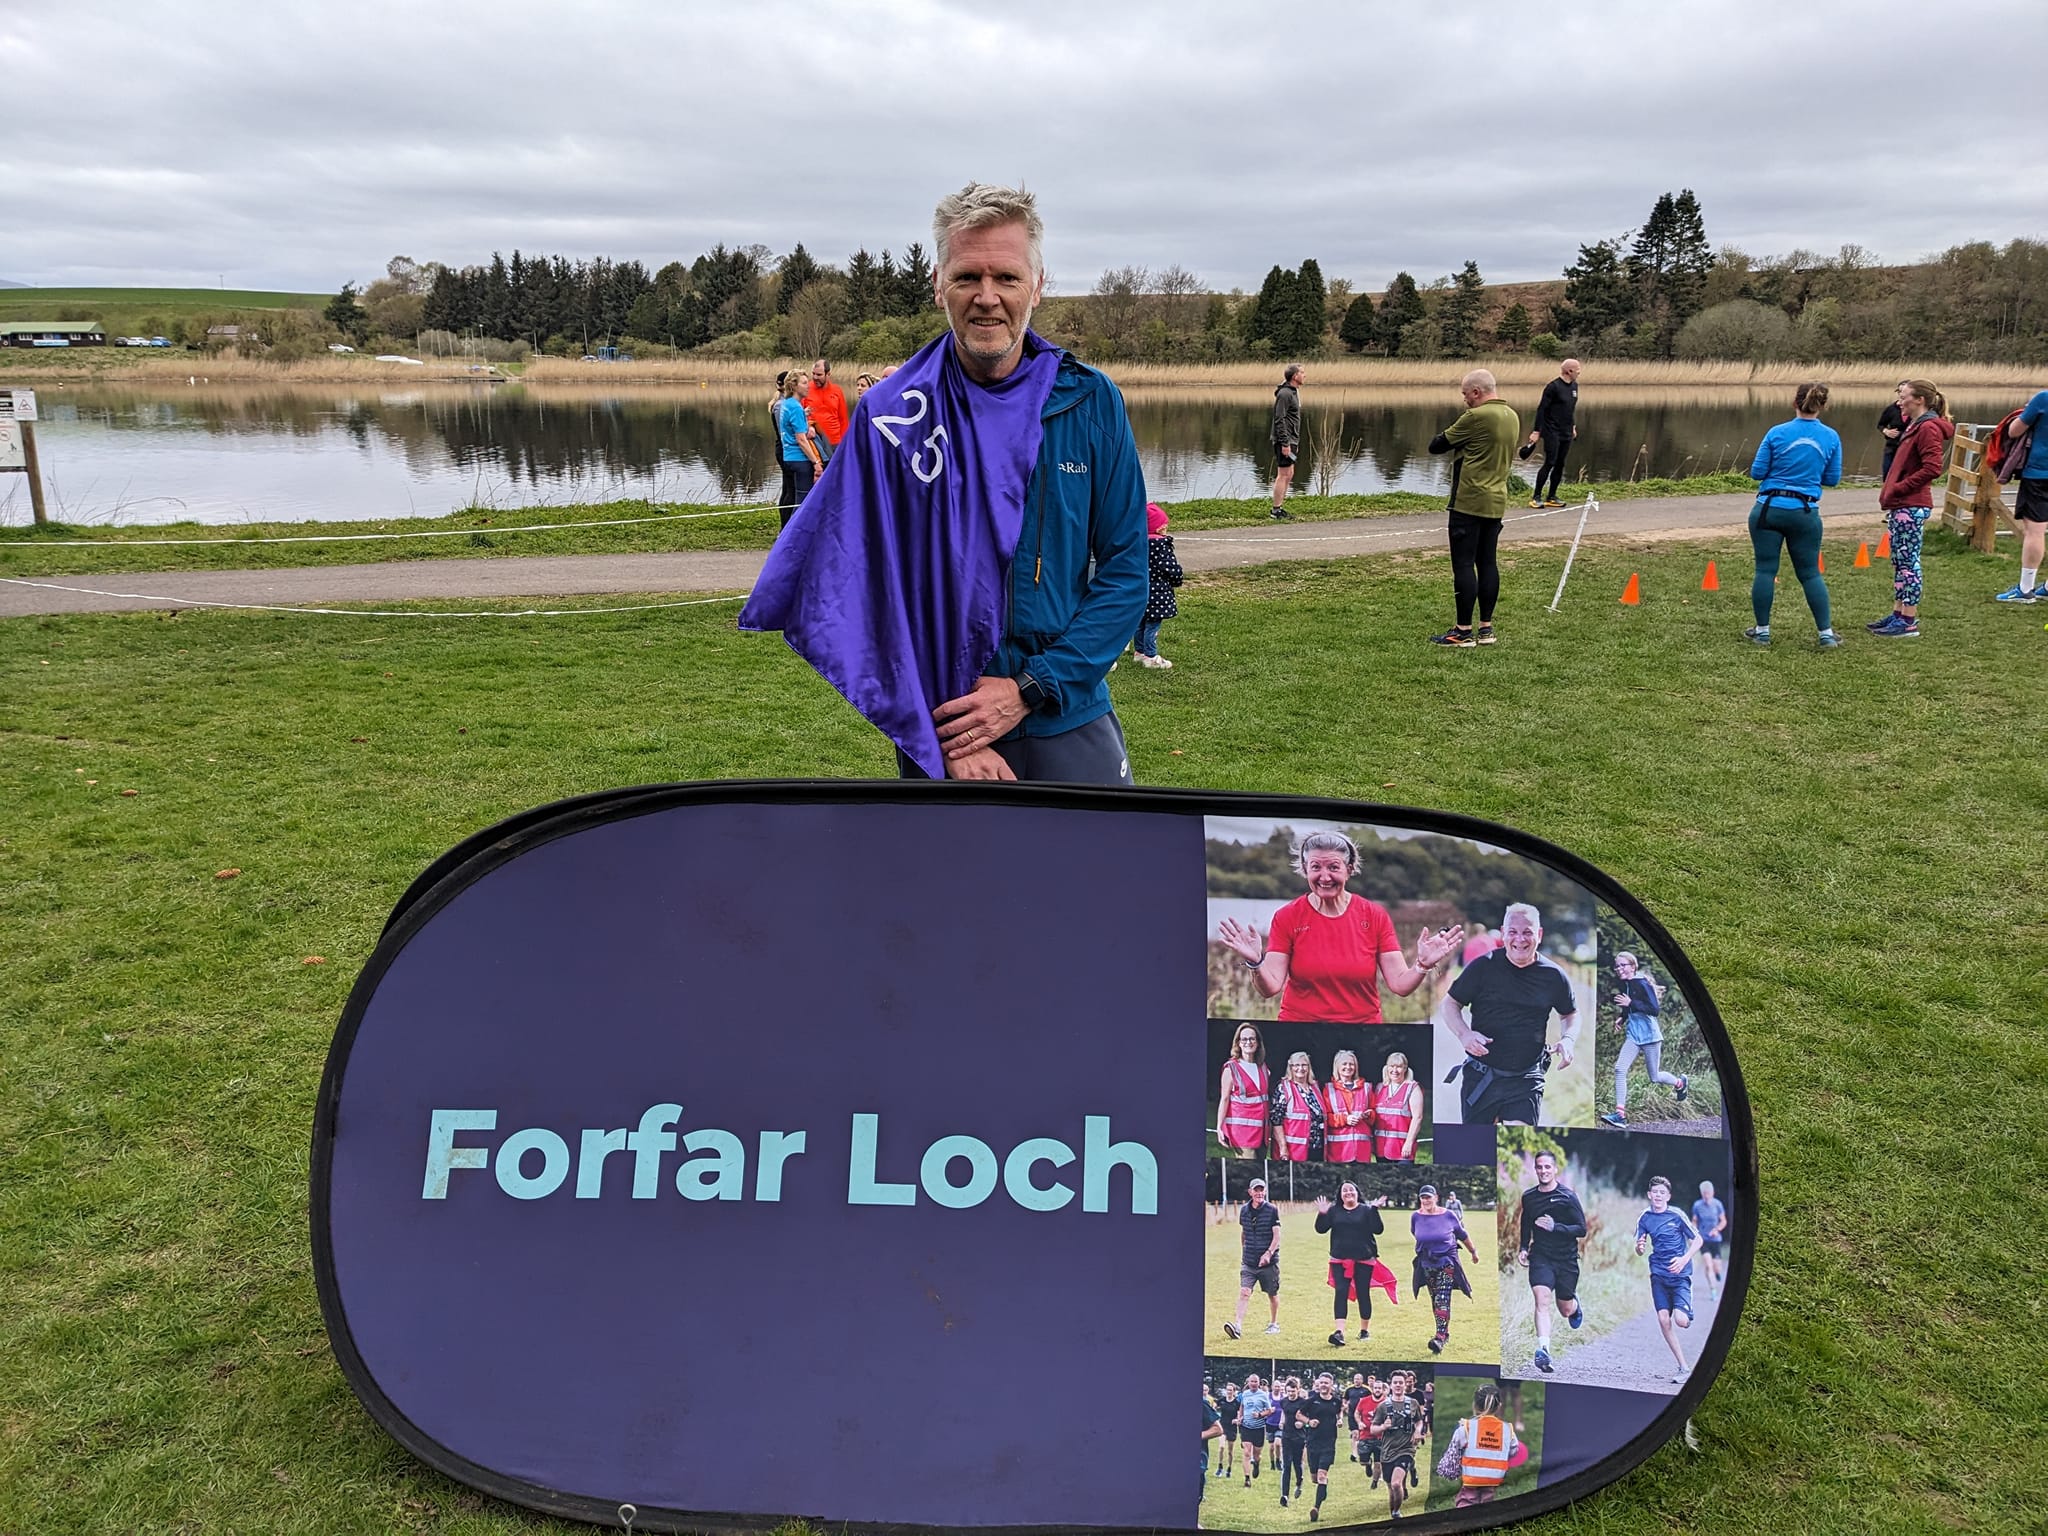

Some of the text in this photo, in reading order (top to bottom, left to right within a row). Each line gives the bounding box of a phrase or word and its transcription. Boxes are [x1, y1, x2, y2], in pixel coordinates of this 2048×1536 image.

[872, 390, 949, 483] 25
[1066, 462, 1088, 473] Rab
[422, 1103, 1158, 1215] Forfar Loch
